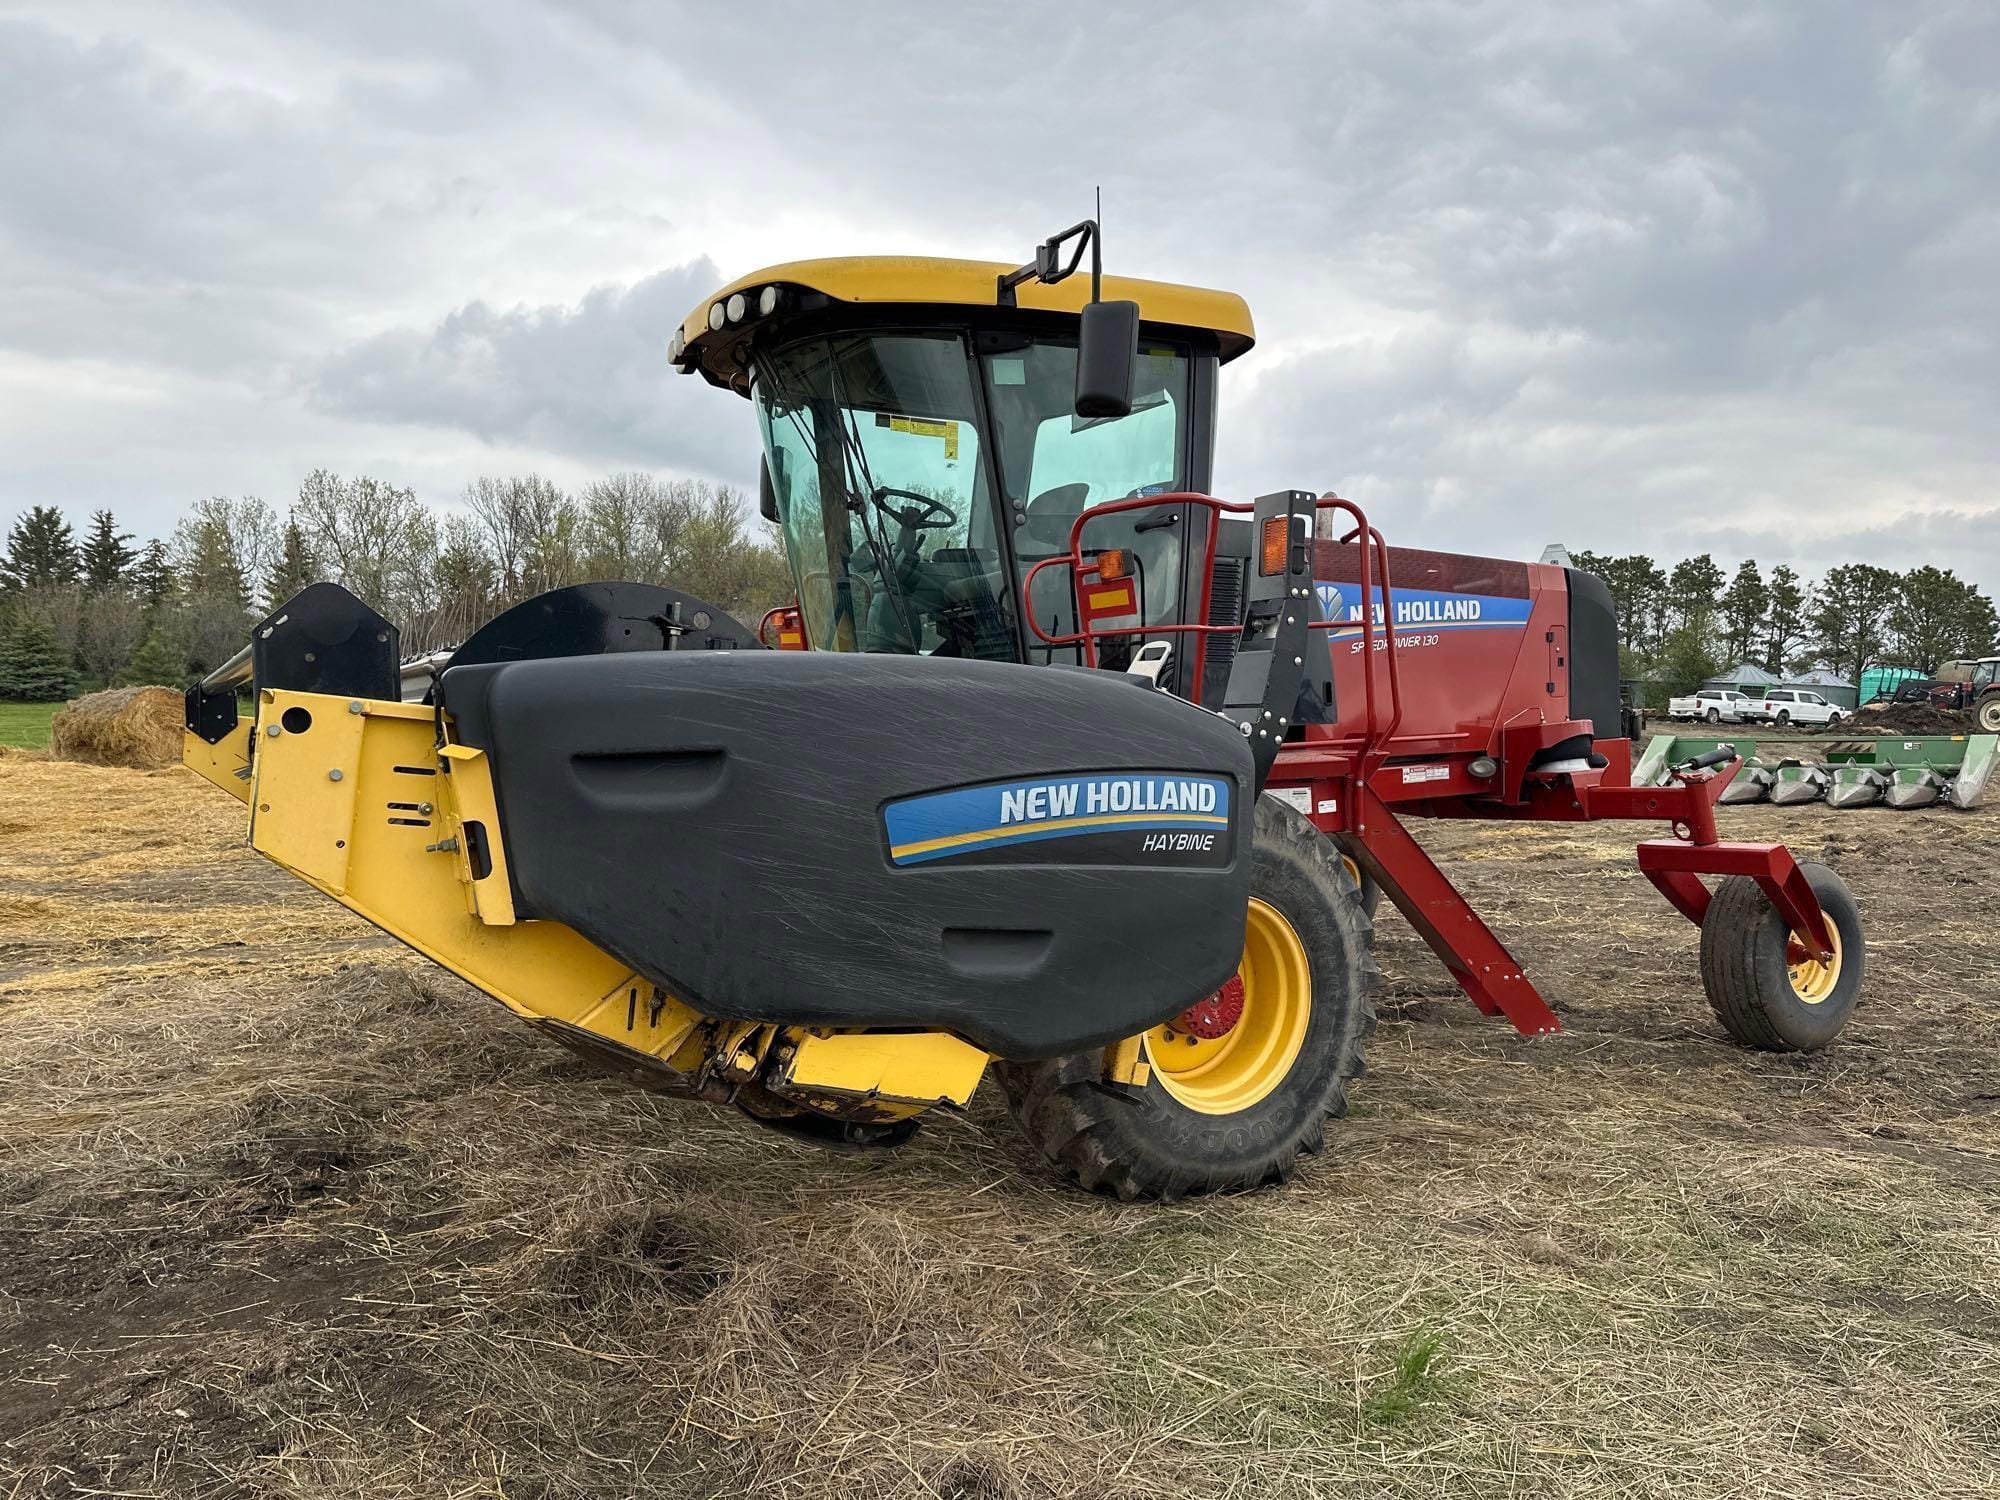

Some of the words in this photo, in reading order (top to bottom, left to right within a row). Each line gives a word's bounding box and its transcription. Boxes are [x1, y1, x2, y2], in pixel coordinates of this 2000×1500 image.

[1398, 600, 1481, 623] HOLLAND
[1423, 634, 1439, 647] 130
[1001, 783, 1079, 824] NEW
[1086, 780, 1216, 815] HOLLAND
[1142, 834, 1215, 851] HAYBINE
